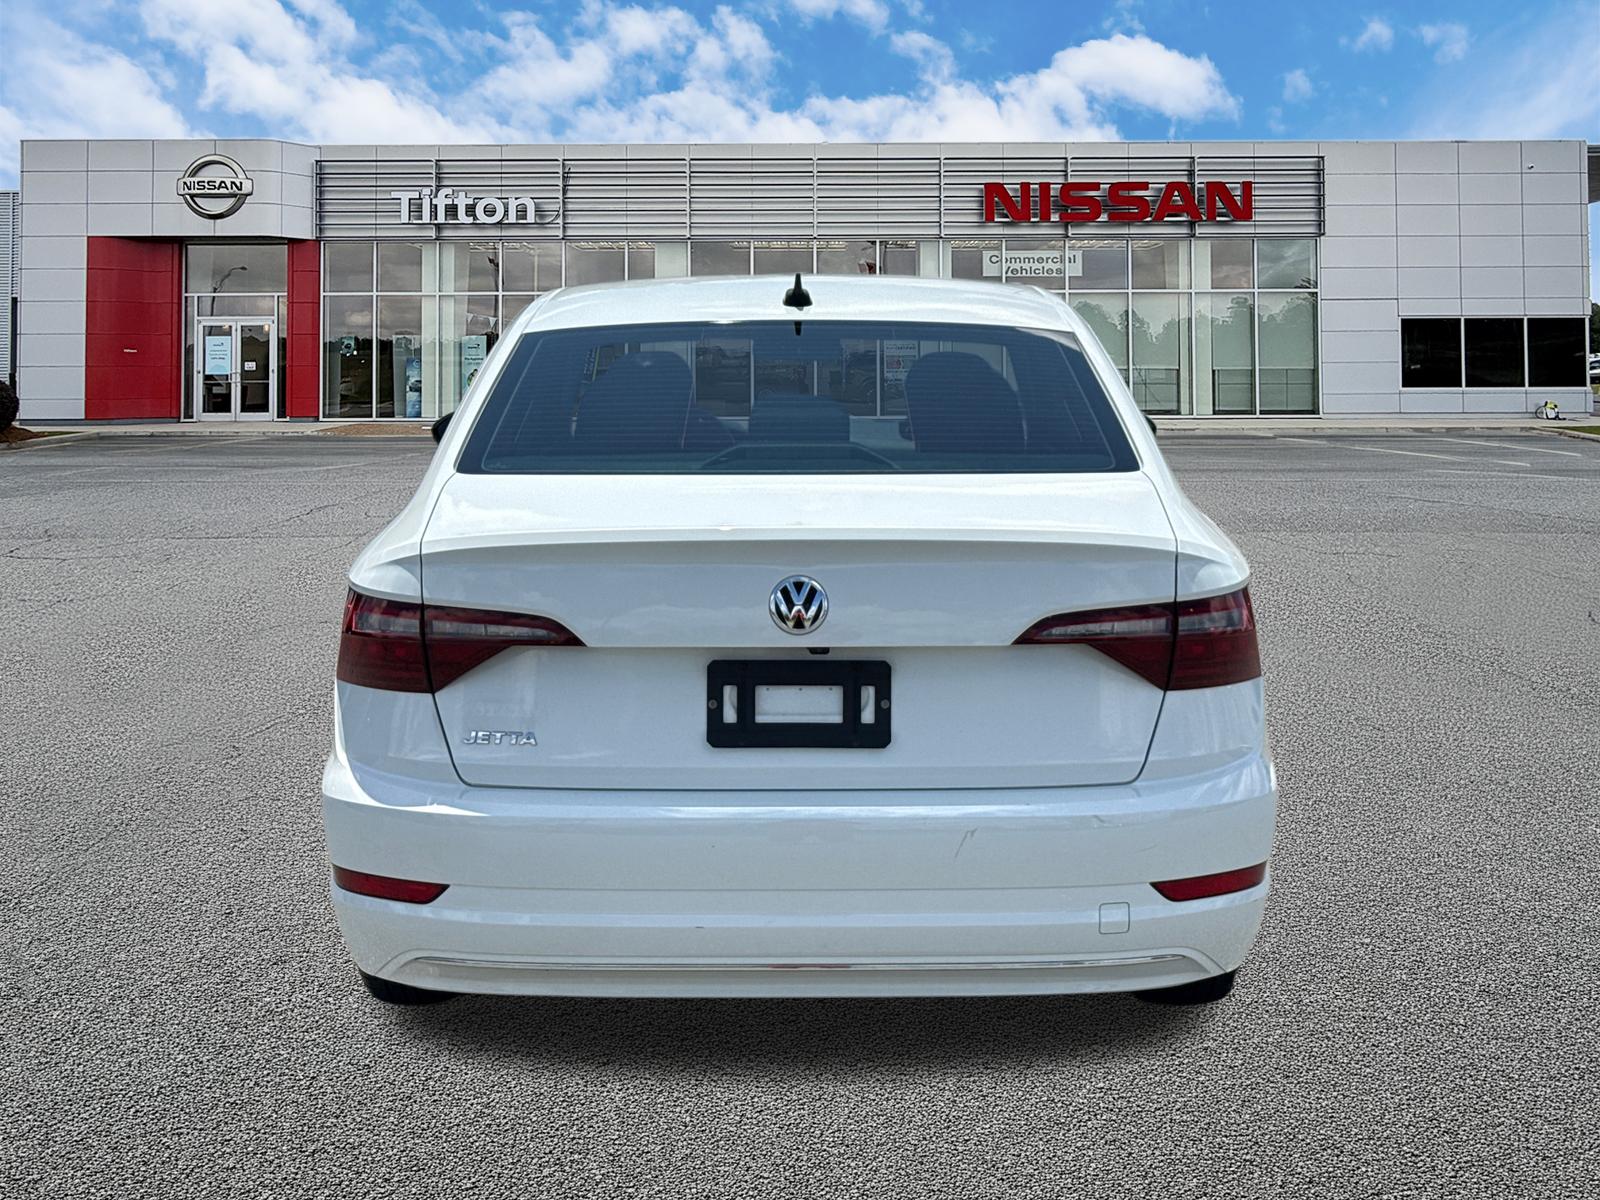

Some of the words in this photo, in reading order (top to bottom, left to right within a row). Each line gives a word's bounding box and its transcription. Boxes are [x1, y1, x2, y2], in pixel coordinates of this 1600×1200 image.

[182, 180, 243, 191] NISSAN
[391, 188, 536, 224] Tifton
[984, 181, 1254, 222] NISSAN
[463, 730, 537, 745] JETTA
